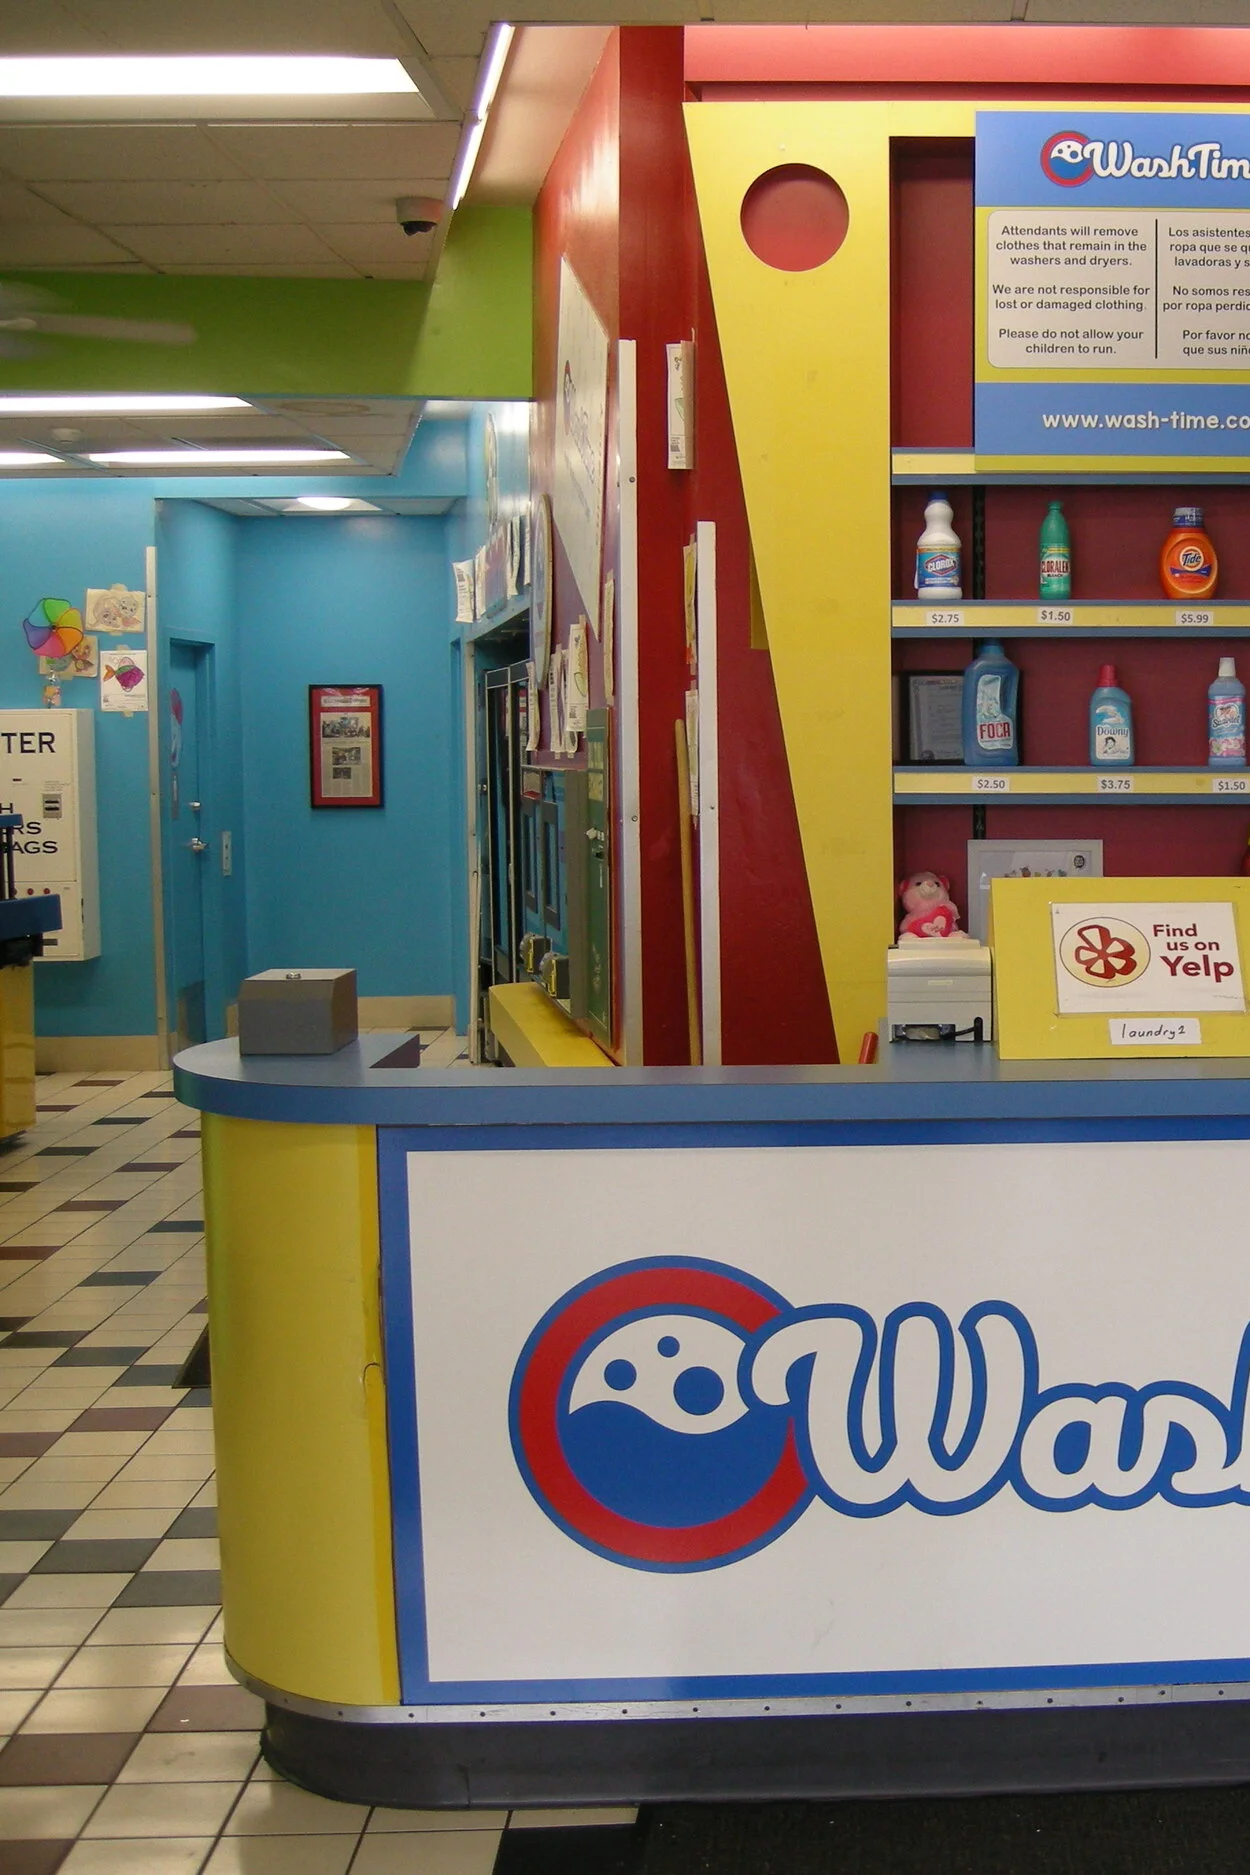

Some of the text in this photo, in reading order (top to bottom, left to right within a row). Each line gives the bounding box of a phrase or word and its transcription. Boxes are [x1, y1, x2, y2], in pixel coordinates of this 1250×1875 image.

[1001, 226, 1139, 239] Attendants will remove
[1169, 227, 1189, 237] Los
[1192, 227, 1250, 238] asistentes
[996, 240, 1147, 251] clothes that remain in the
[1170, 244, 1196, 254] ropa
[1199, 244, 1221, 254] que
[1010, 255, 1132, 268] washers and dryers.
[1175, 256, 1231, 267] lavadoras
[1234, 260, 1241, 269] y
[992, 284, 1011, 294] We
[1038, 285, 1057, 294] not
[1060, 285, 1130, 297] responsible
[1133, 285, 1150, 295] for
[1173, 286, 1189, 295] No
[1192, 288, 1229, 296] somos
[996, 299, 1147, 312] lost or damaged clothing.
[1163, 303, 1182, 312] por
[1186, 303, 1212, 313] ropa
[999, 328, 1144, 343] Please do not allow your
[1183, 330, 1203, 340] Por
[1205, 330, 1236, 340] favor
[1026, 344, 1116, 354] children to run.
[1183, 347, 1204, 356] que
[1208, 347, 1227, 355] sus
[928, 559, 955, 572] CLOROX
[1182, 553, 1202, 566] Tide
[932, 613, 959, 624] $2.75
[1041, 610, 1071, 622] $1.50
[1181, 613, 1209, 624] $5.99
[980, 722, 1011, 740] FOCA
[1097, 726, 1129, 738] Downy
[1, 732, 56, 754] TER
[977, 779, 1006, 790] $2.50
[1101, 779, 1131, 790] $3.75
[1218, 780, 1246, 791] $1.50
[12, 822, 42, 835] RS
[12, 841, 58, 854] AGS
[1153, 924, 1198, 938] Find
[1167, 941, 1220, 951] us on
[1161, 954, 1234, 983] Yelp
